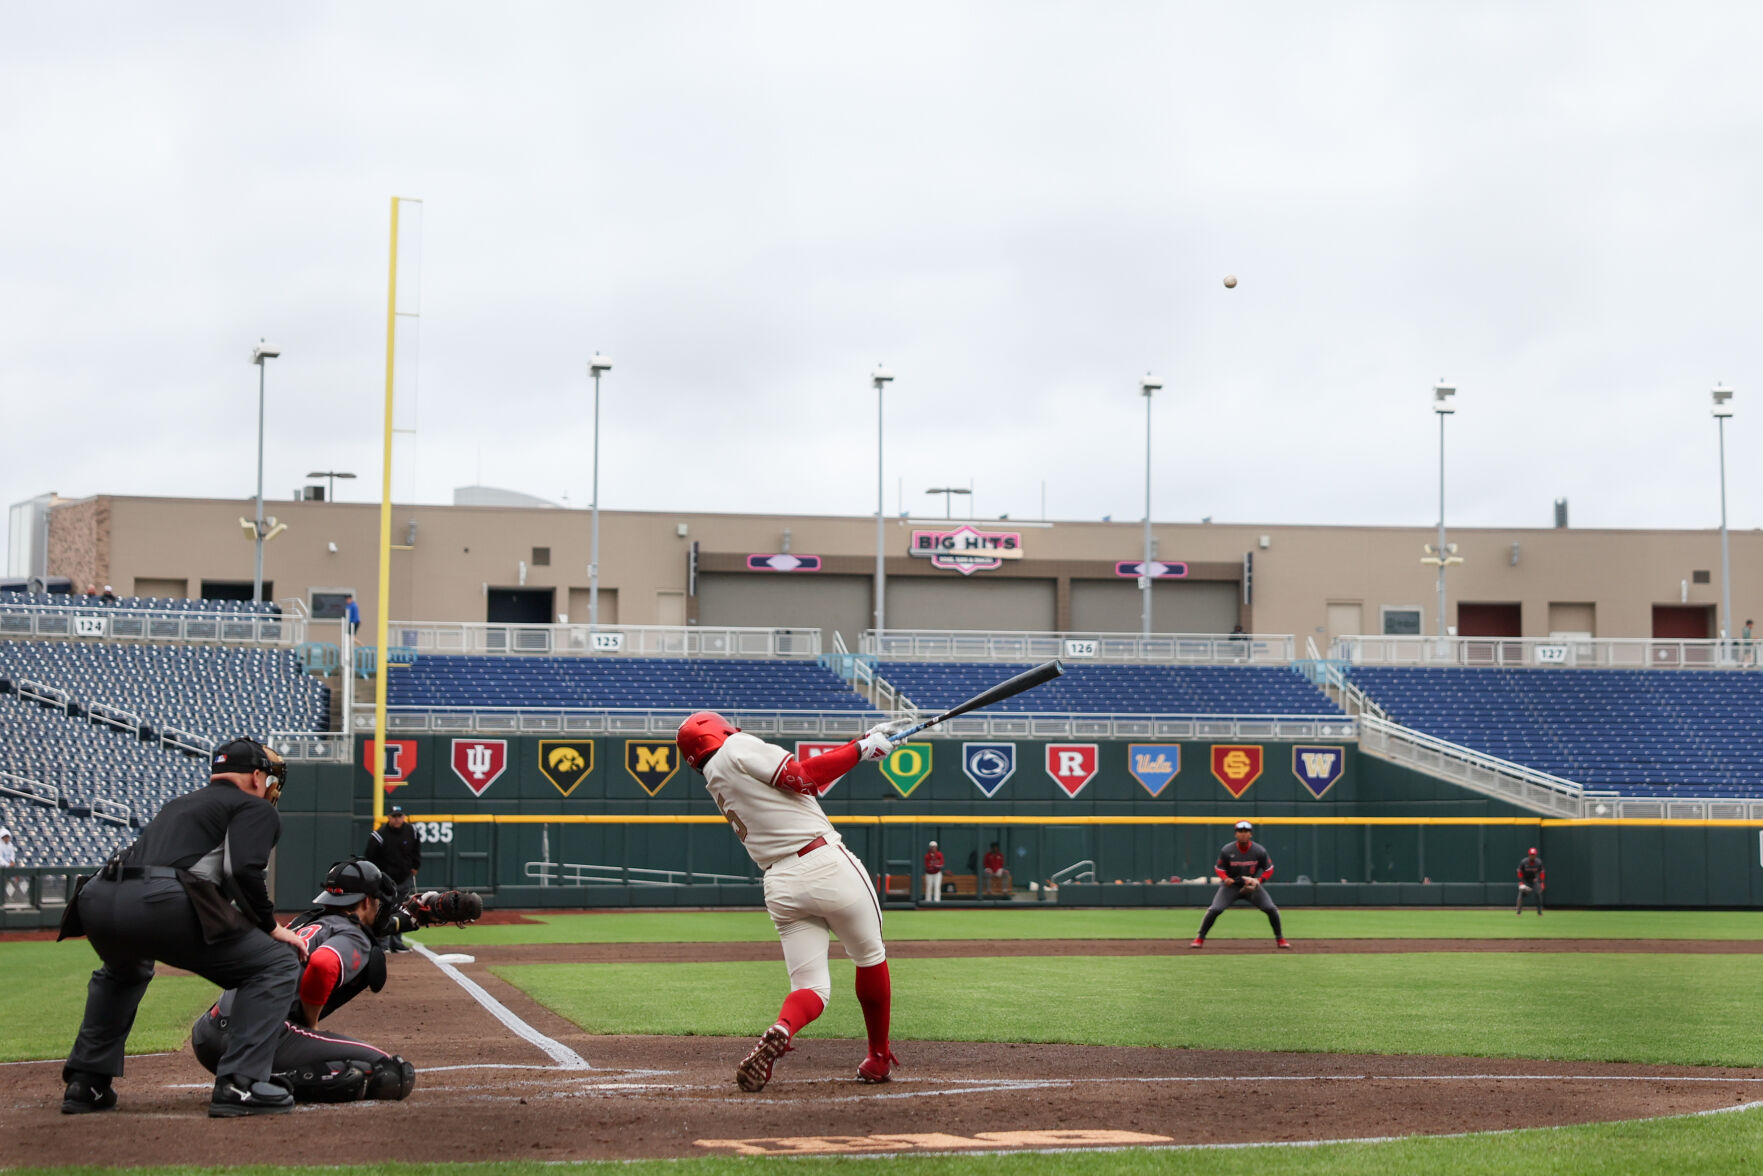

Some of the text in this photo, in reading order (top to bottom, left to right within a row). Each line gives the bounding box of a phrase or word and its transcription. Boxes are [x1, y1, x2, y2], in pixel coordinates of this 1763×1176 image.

[919, 536, 1016, 549] BIG HITS
[80, 620, 102, 631] 124
[597, 636, 618, 646] 125
[1071, 643, 1093, 653] 126
[1541, 649, 1562, 658] 127
[635, 746, 670, 772] M
[890, 749, 922, 776] O
[1058, 751, 1087, 776] R
[1301, 753, 1336, 778] W
[415, 822, 454, 843] 335
